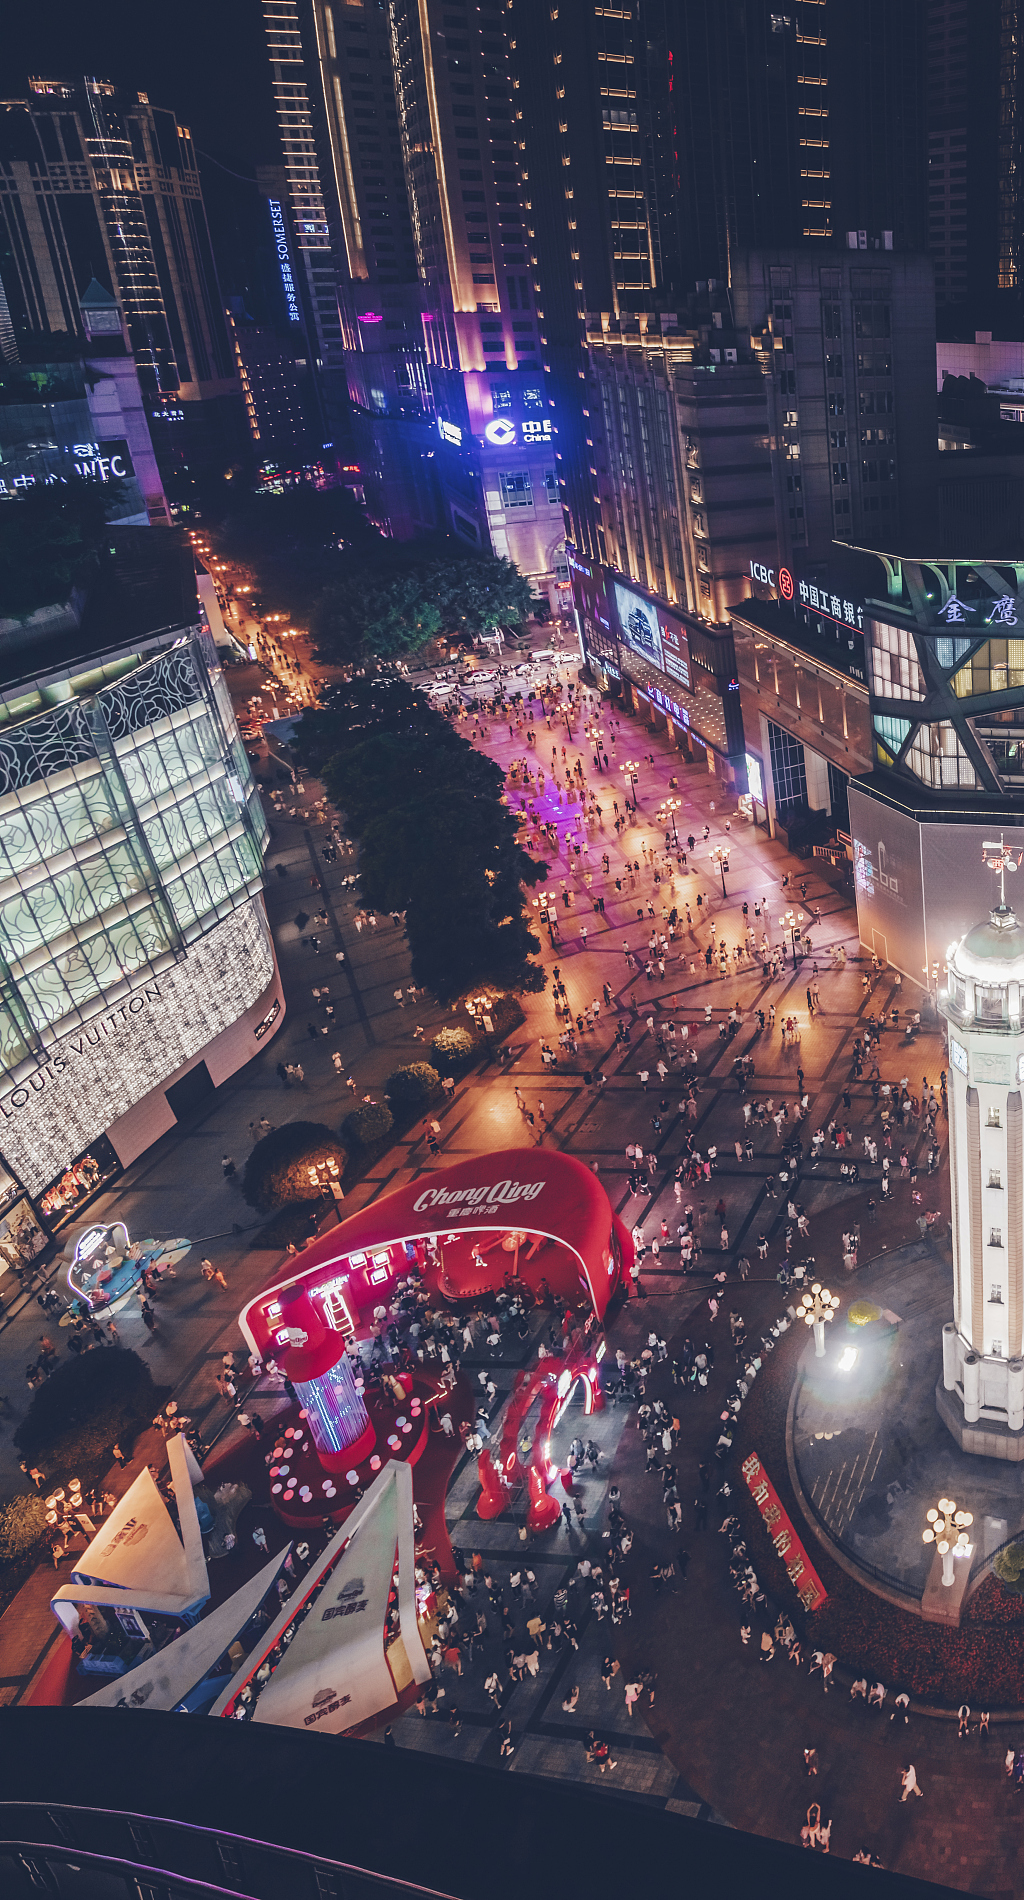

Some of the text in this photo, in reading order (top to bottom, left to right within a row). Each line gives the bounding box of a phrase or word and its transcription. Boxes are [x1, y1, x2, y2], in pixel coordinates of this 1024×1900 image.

[268, 198, 290, 260] SOMERSET
[749, 560, 776, 588] ICBC
[0, 983, 162, 1119] LOUIS VUITTON
[741, 1455, 822, 1613] 我和我的祖国
